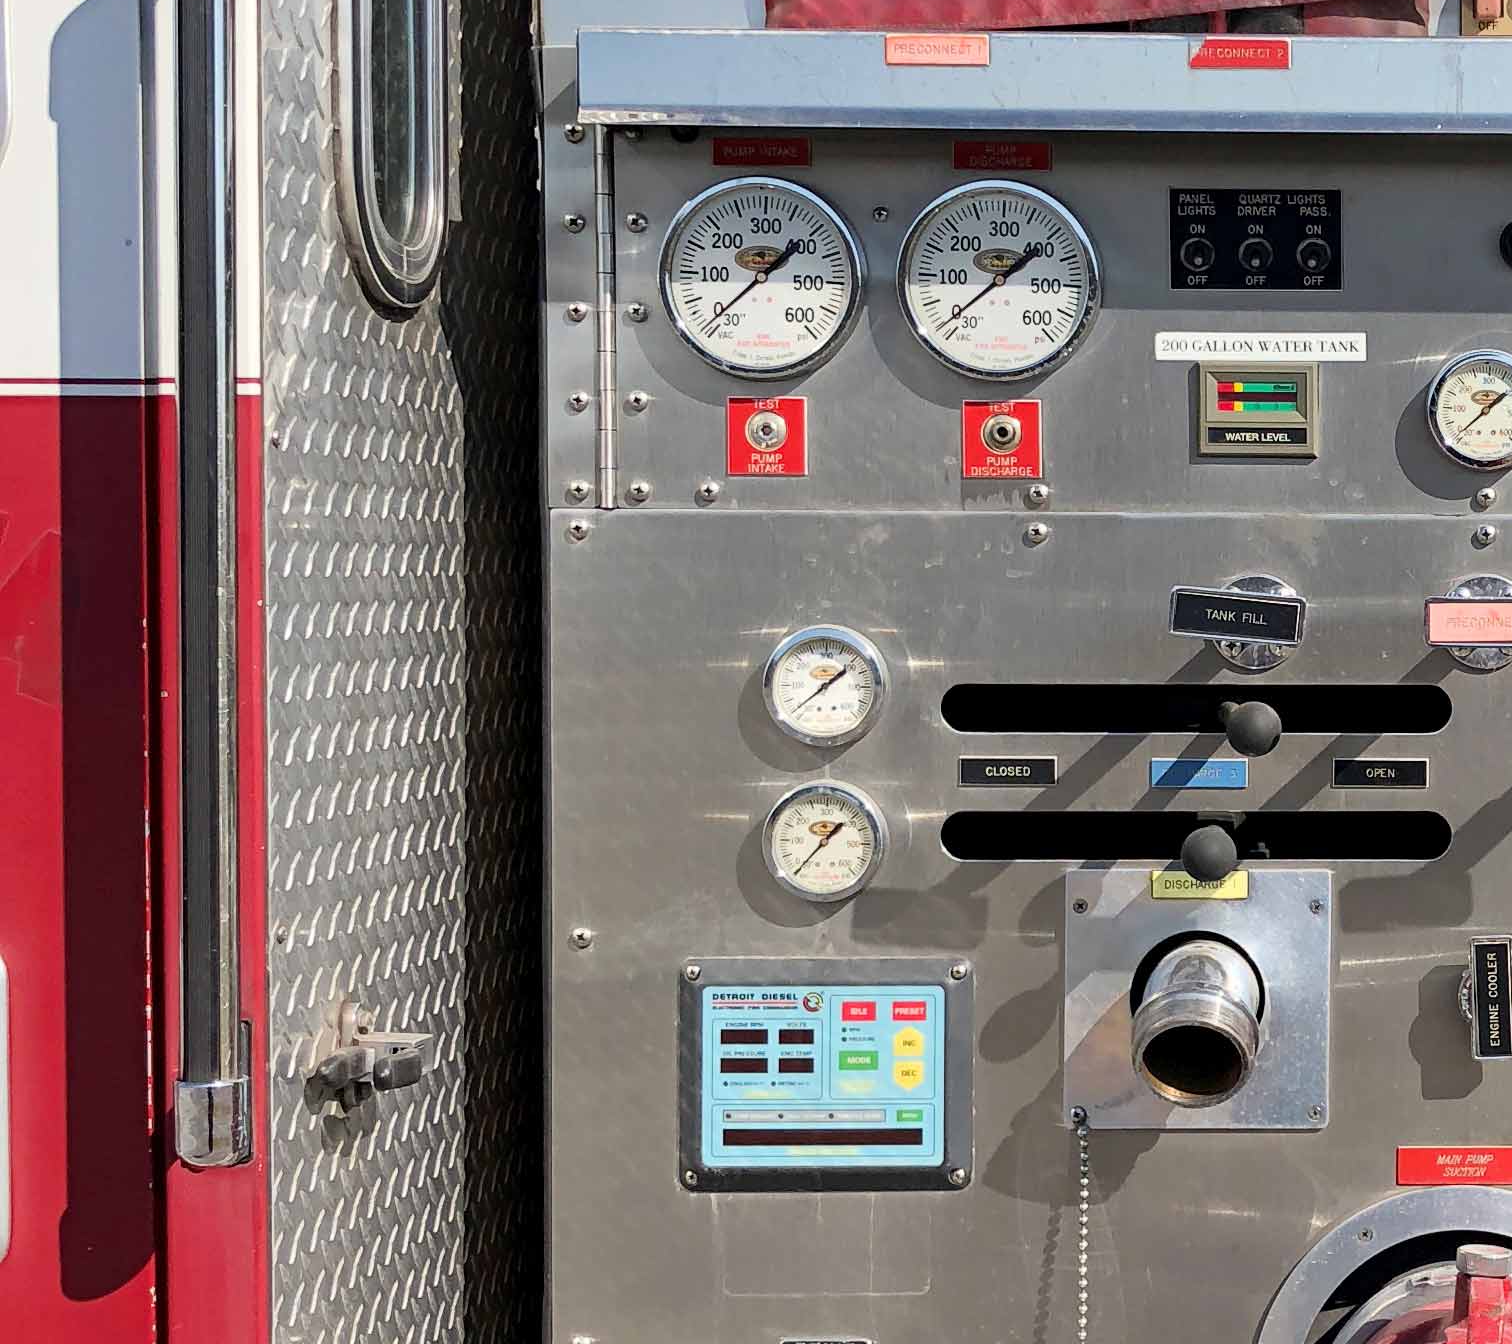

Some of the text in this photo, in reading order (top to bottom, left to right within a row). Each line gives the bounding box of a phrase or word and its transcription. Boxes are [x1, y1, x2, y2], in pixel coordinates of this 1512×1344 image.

[1478, 20, 1498, 31] OFF
[894, 43, 972, 55] PRECONNECT
[1277, 48, 1284, 58] 2
[722, 145, 799, 158] PUMP INTAKE
[984, 142, 1017, 154] PUMP
[969, 156, 1033, 168] DISCHARGE
[1179, 194, 1214, 204] PANEL
[1239, 194, 1326, 205] QUARTZ LIGHTS
[1178, 206, 1216, 216] LIGHTS
[1237, 207, 1277, 217] DRIVER
[1300, 207, 1331, 217] PASS.
[750, 217, 782, 234] 300
[988, 220, 1021, 238] 300
[1190, 224, 1206, 234] ON
[1247, 224, 1264, 234] ON
[1305, 224, 1322, 235] ON
[711, 232, 744, 250] 200
[949, 235, 982, 253] 200
[1022, 241, 1055, 258] 400
[700, 266, 730, 283] 100
[939, 268, 968, 285] 100
[1187, 275, 1208, 285] OFF
[793, 274, 824, 291] 500
[1030, 278, 1062, 294] 500
[1245, 275, 1267, 286] OFF
[1303, 275, 1325, 286] OFF
[713, 301, 724, 317] 0
[951, 304, 962, 320] 0
[785, 307, 815, 323] 600
[1022, 310, 1053, 326] 600
[717, 331, 734, 340] VAC
[955, 333, 972, 342] VAC
[1161, 340, 1360, 353] 200 GALLON WATER TANK
[752, 399, 780, 409] TEST
[987, 402, 1016, 412] TEST
[1225, 431, 1291, 442] WATER LEVEL
[751, 453, 783, 464] PUMP
[986, 456, 1018, 467] PUMP
[748, 463, 785, 473] INTAKE
[970, 466, 1034, 476] DISCHARGE
[1205, 607, 1267, 626] TANK FILL
[985, 764, 1031, 778] CLOSED
[1365, 766, 1396, 779] OPEN
[1164, 879, 1226, 890] DISCHARGE
[712, 993, 798, 1001] DETROIT DIESEL
[1487, 951, 1501, 1048] ENGINE COOLER
[850, 1007, 868, 1015] IDLE
[894, 1007, 925, 1015] PRESET
[847, 1056, 872, 1064] MODE
[1436, 1154, 1494, 1165] MAIN PUMP
[1443, 1166, 1488, 1177] SUCTION
